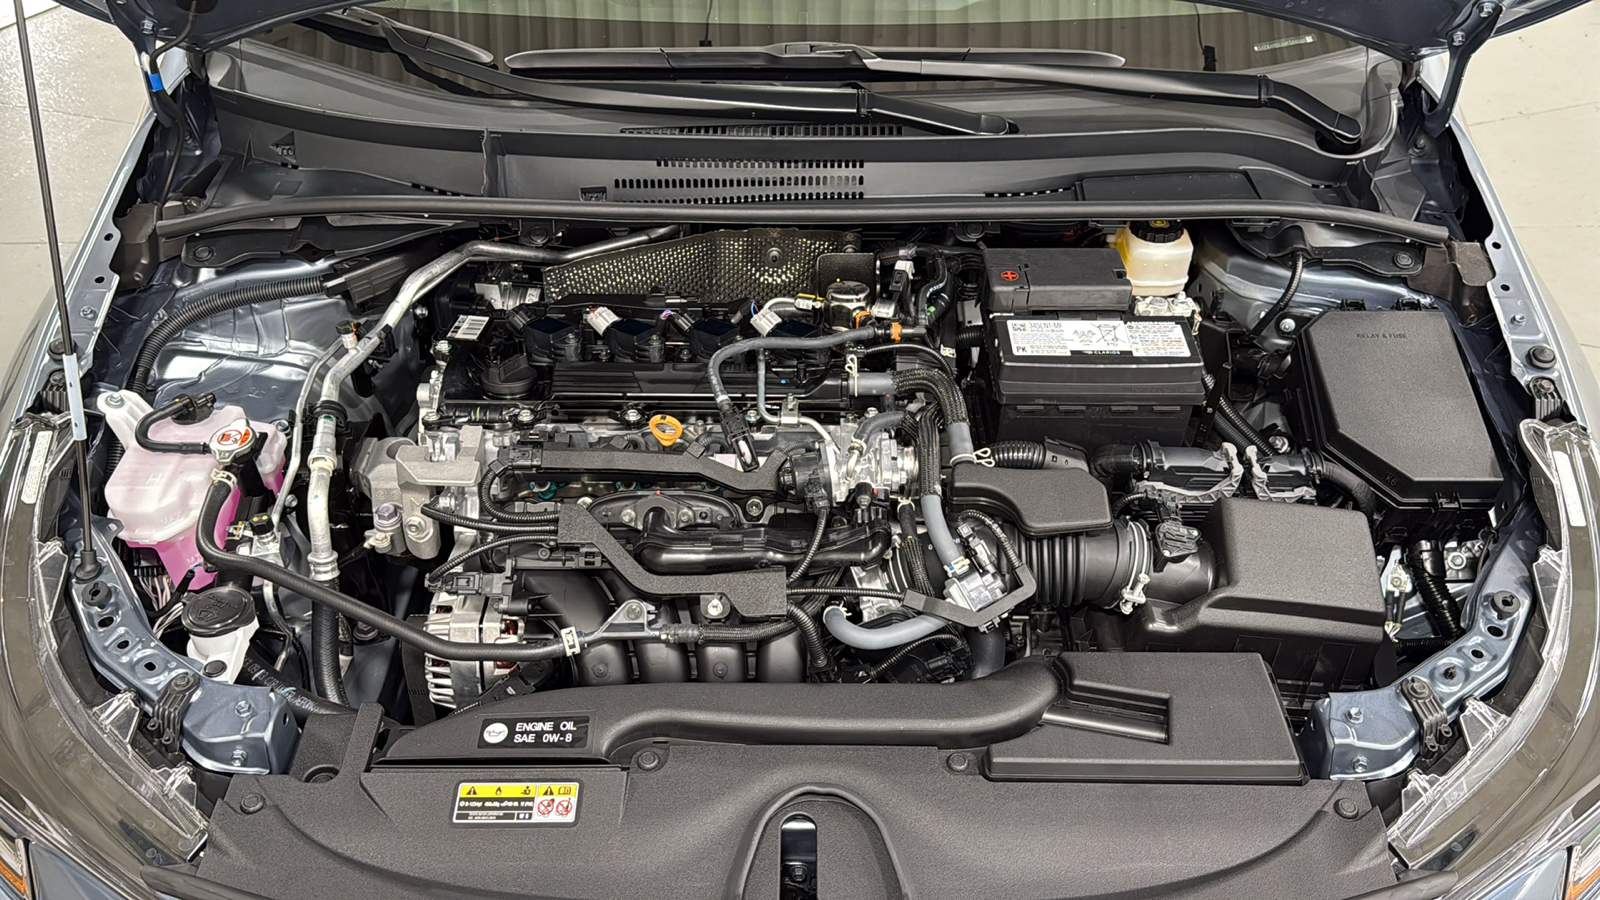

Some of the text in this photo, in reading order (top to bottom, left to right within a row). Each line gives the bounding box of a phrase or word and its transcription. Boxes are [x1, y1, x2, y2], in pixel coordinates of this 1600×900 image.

[515, 721, 577, 732] ENGINE OIL
[513, 732, 573, 743] SAE 0W-8
